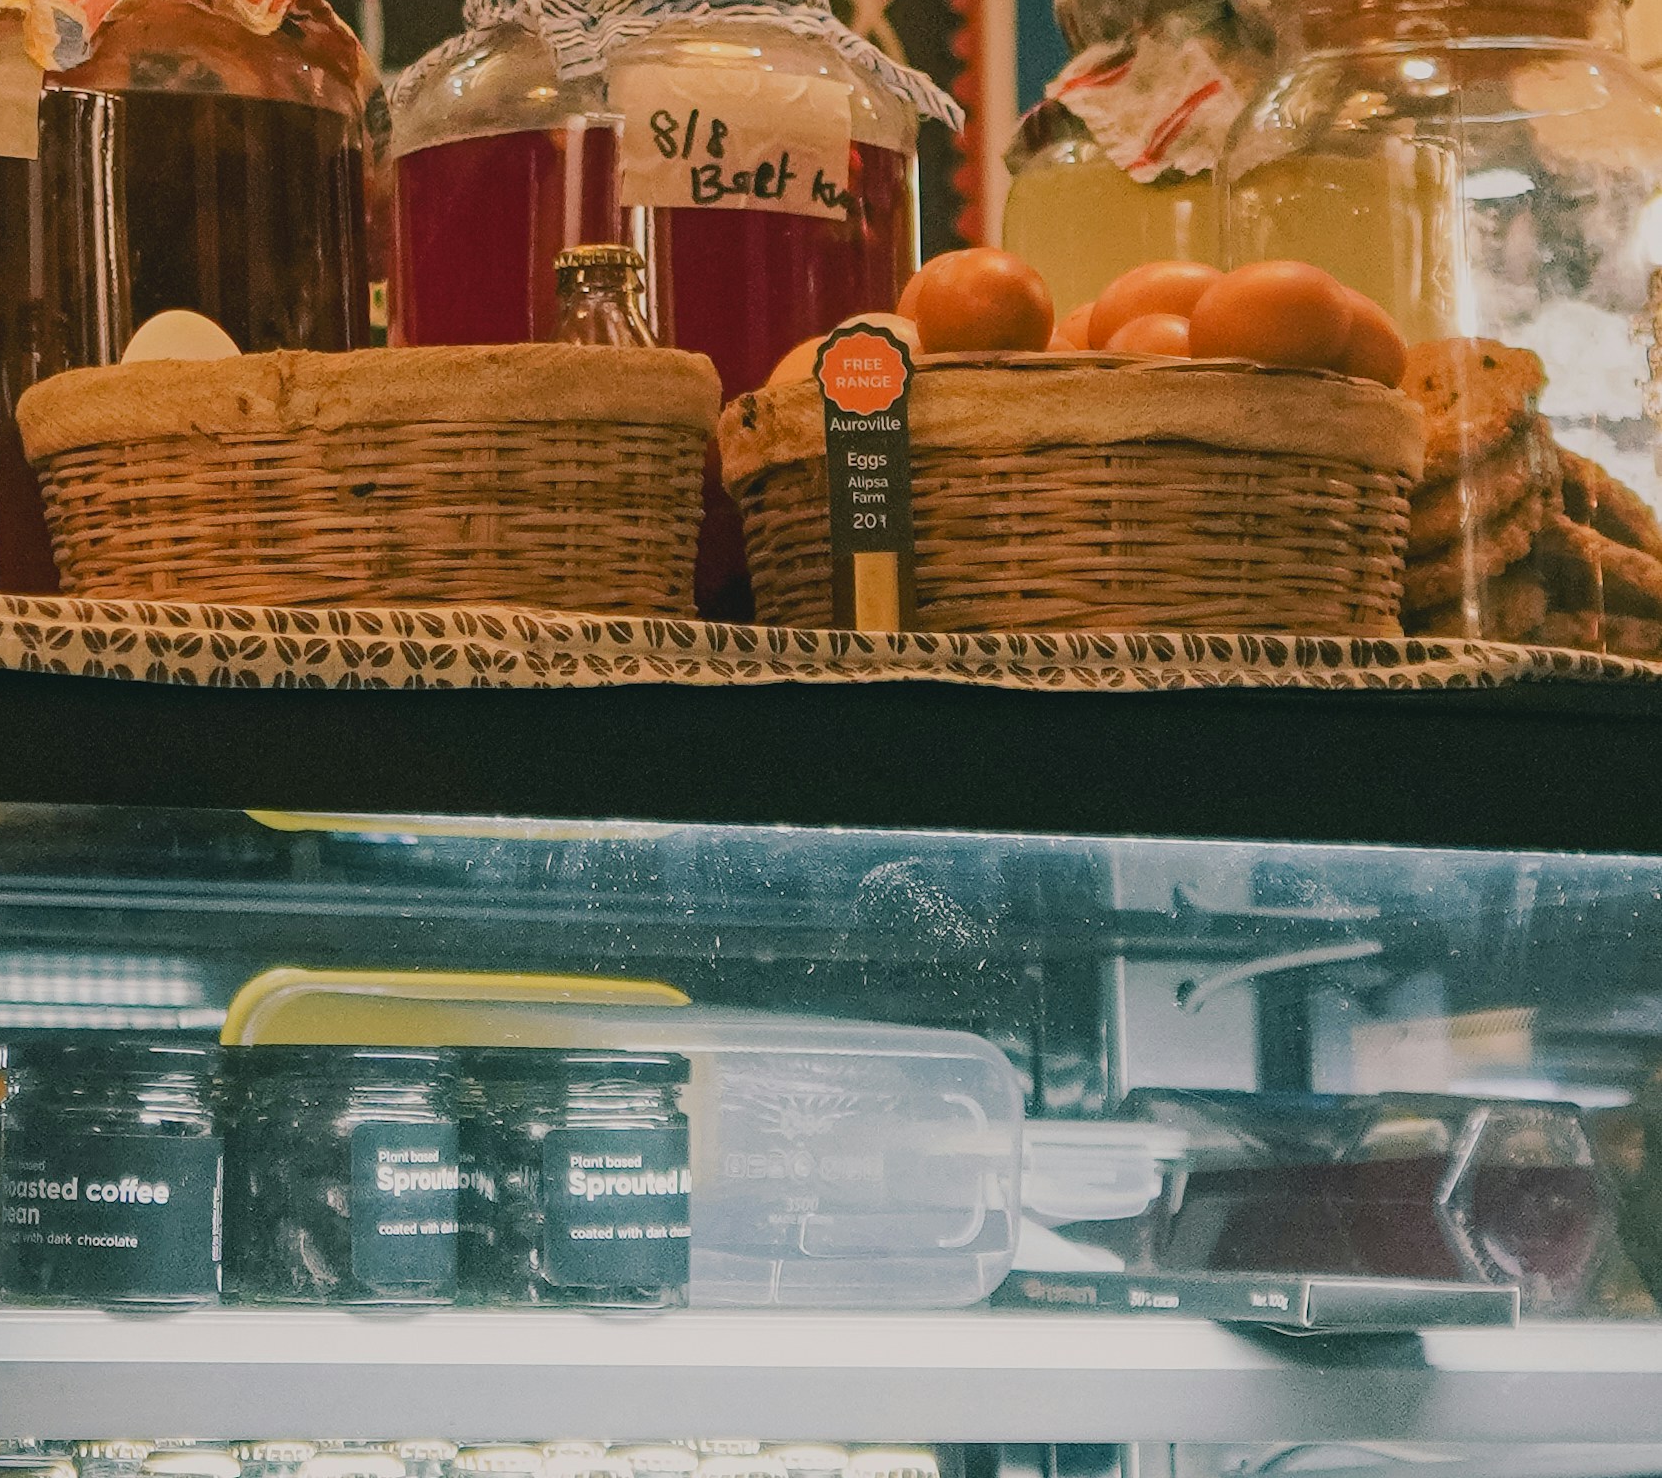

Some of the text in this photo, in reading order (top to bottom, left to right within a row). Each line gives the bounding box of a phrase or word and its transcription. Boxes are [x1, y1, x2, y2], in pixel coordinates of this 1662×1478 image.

[650, 108, 728, 160] 8/8
[843, 358, 882, 371] FREE
[836, 375, 892, 388] RANGE
[830, 416, 901, 432] Auroville
[847, 452, 888, 470] Eggs
[848, 476, 888, 490] Alipsa
[852, 492, 886, 504] Farm
[378, 1149, 439, 1163] Plant based
[570, 1154, 642, 1169] Plant based
[86, 1176, 169, 1204] coffee
[569, 1169, 678, 1201] Sprouted
[378, 1222, 417, 1235] coated
[570, 1226, 614, 1240] coated
[618, 1226, 642, 1239] with
[646, 1226, 667, 1239] dark
[47, 1232, 72, 1245] dark
[77, 1233, 138, 1248] chocolate
